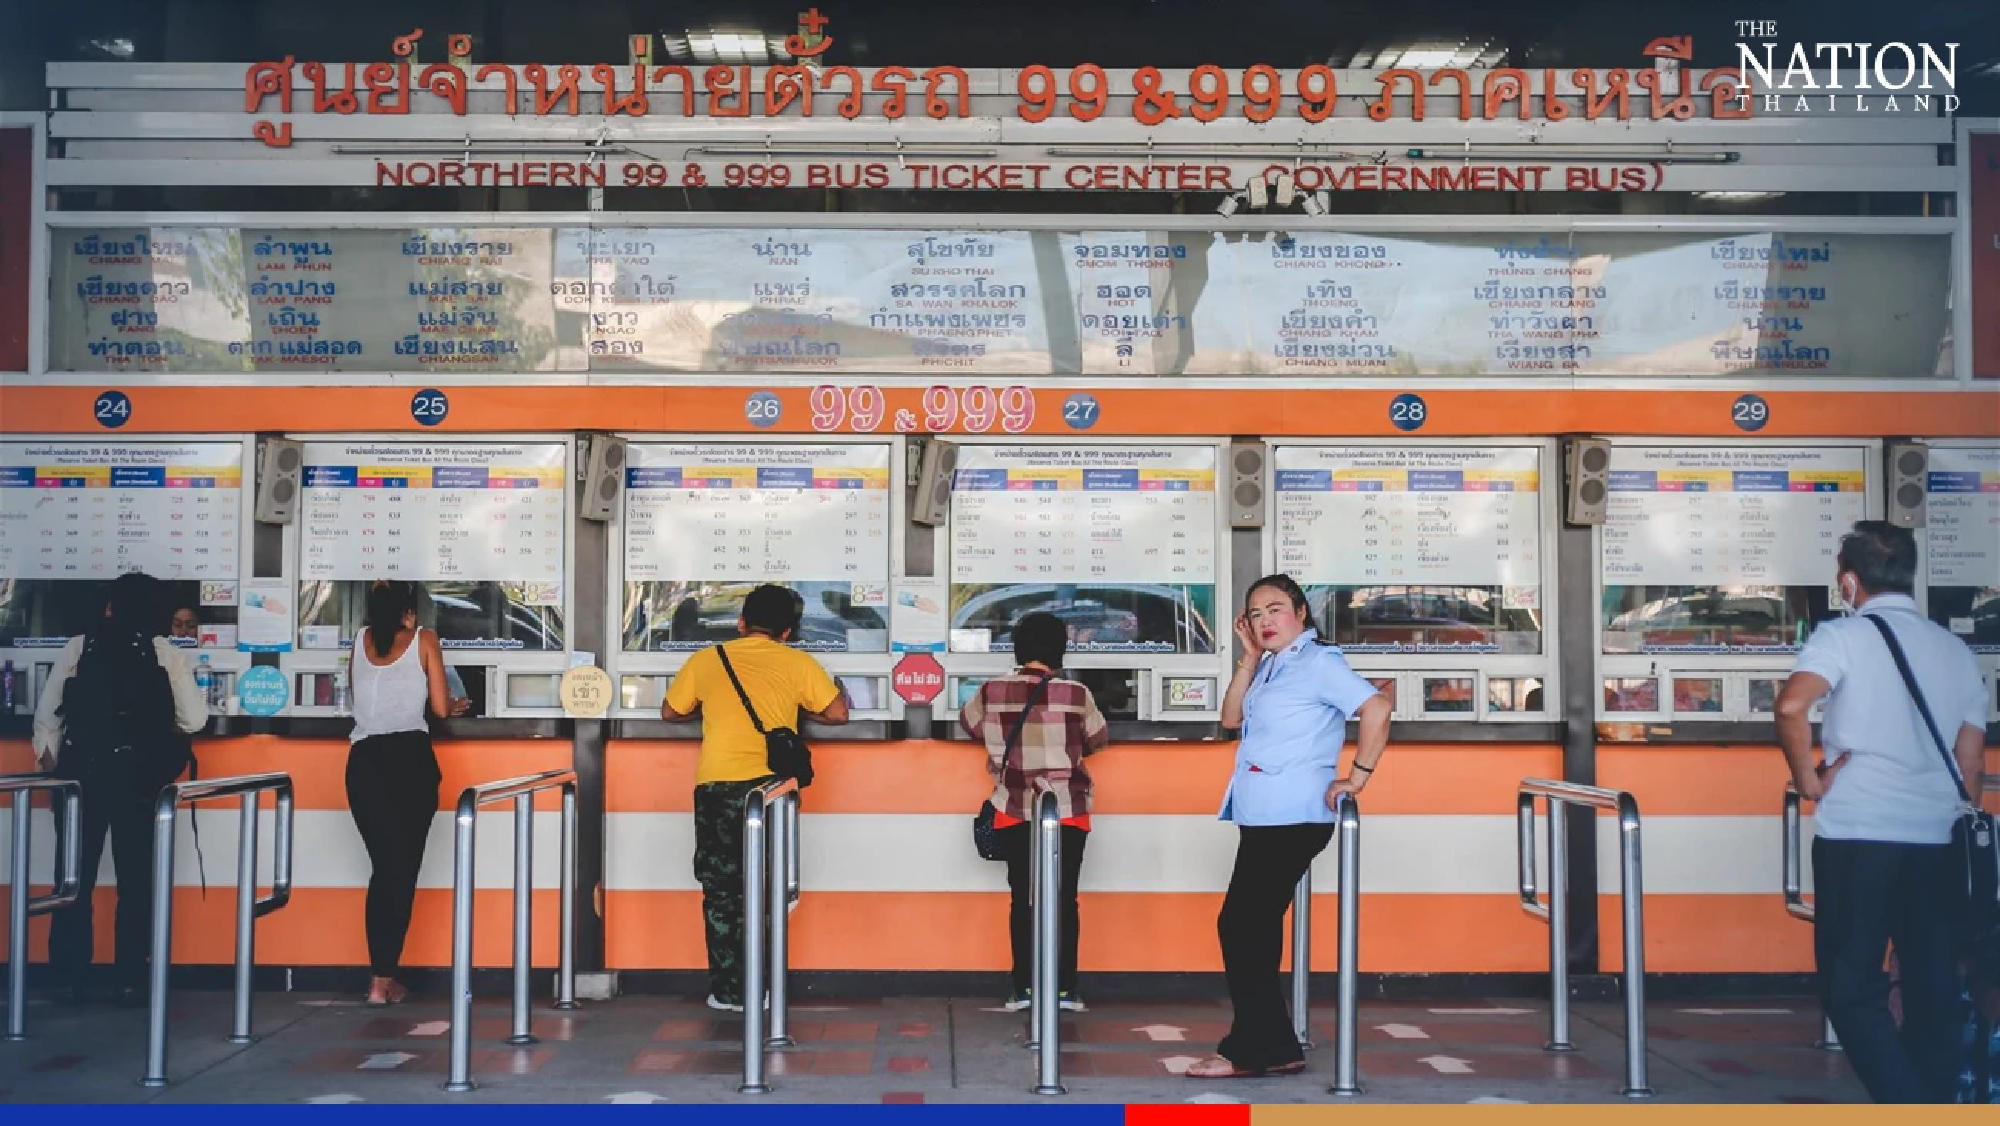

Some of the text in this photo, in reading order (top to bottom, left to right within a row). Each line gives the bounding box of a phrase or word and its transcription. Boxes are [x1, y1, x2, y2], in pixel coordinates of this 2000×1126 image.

[243, 7, 970, 147] ศูนย์จำหน่ายตั๋วรถ
[1016, 62, 1109, 123] 99
[1368, 35, 1755, 123] ภาคเหนือ
[376, 160, 606, 188] NORTHERN
[622, 162, 668, 188] 99
[681, 162, 707, 188] &
[725, 162, 792, 188] 999
[807, 163, 890, 188] BUS
[911, 163, 1051, 189] TICKET
[1066, 164, 1233, 190] CENTER
[1567, 161, 1665, 192] BUS)
[74, 234, 198, 255] เชียงใหม่
[253, 235, 333, 264] ลำพูน
[402, 235, 513, 255] เชียงราย
[752, 237, 813, 257] น่าน
[906, 237, 995, 265] สุโขทัย
[1074, 245, 1186, 258] จอมทอง
[1272, 238, 1386, 258] เชียงของ
[1711, 240, 1830, 262] เชียงใหม่
[88, 256, 142, 265] CHIANG
[256, 263, 332, 271] LAM PHUN
[418, 257, 471, 265] CHIANG
[769, 257, 798, 265] NAN
[1274, 260, 1326, 268] CHIANG
[77, 275, 190, 295] เชียงดาว
[251, 275, 335, 295] ลำปาง
[408, 277, 503, 295] แม่สาย
[754, 277, 810, 295] แพร่
[891, 277, 1026, 297] สวรรคโลก
[1097, 285, 1152, 298] ฮอด
[1306, 279, 1352, 298] เทิง
[1474, 280, 1606, 298] เชียงกลาง
[1714, 280, 1826, 300] เชียงราย
[257, 296, 332, 304] LAM PANG
[759, 297, 806, 305] PHRAE
[111, 308, 158, 325] ฝาง
[268, 305, 322, 325] เถิน
[418, 305, 499, 325] แม่จัน
[592, 312, 639, 325] งาว
[869, 305, 1026, 327] กำแพงเพชร
[1082, 309, 1186, 328] ดอยเต่า
[1282, 309, 1378, 328] เชียงคำ
[1489, 311, 1592, 329] ท่าวังผา
[1743, 311, 1803, 330] น่าน
[118, 325, 155, 333] FANG
[88, 337, 186, 355] ท่าตอน
[394, 334, 519, 355] เชียงแสน
[591, 340, 643, 354] สอง
[1274, 337, 1398, 357] เชียงม่วน
[1496, 339, 1592, 358] เวียงสา
[922, 358, 976, 366] PHICHIT
[1507, 361, 1554, 369] WIANG
[97, 399, 129, 418] 24
[414, 398, 446, 416] 25
[748, 400, 778, 418] 26
[810, 385, 1036, 433] 99 & 999
[1065, 400, 1097, 419] 27
[1393, 402, 1425, 421] 28
[1734, 403, 1767, 421] 29
